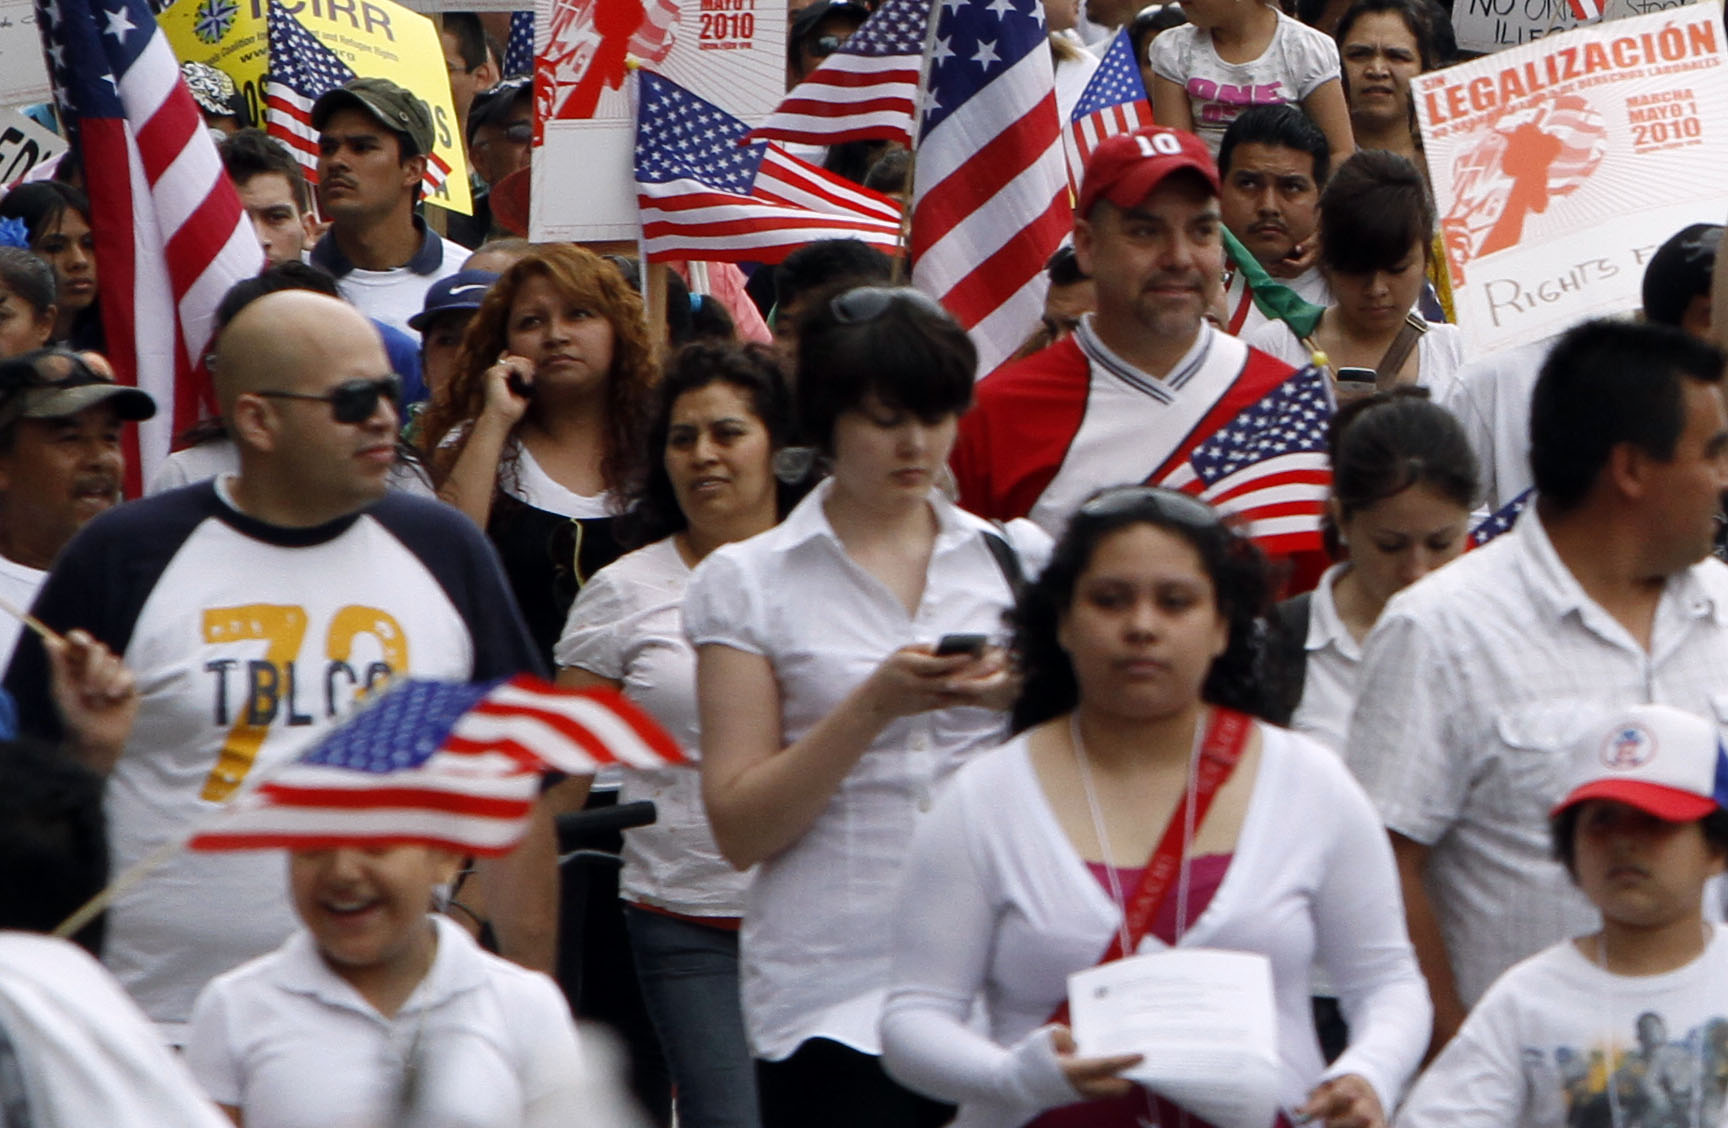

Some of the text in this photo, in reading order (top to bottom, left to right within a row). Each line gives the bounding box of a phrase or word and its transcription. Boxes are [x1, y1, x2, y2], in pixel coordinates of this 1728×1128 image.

[699, 13, 755, 40] 2010
[1424, 19, 1719, 127] LEGALIZACIÓN
[1625, 88, 1694, 107] MARCHA
[1627, 101, 1699, 124] MAYO 1
[1134, 132, 1184, 158] 10
[1632, 116, 1702, 148] 2010
[1483, 257, 1620, 328] RIGHTS
